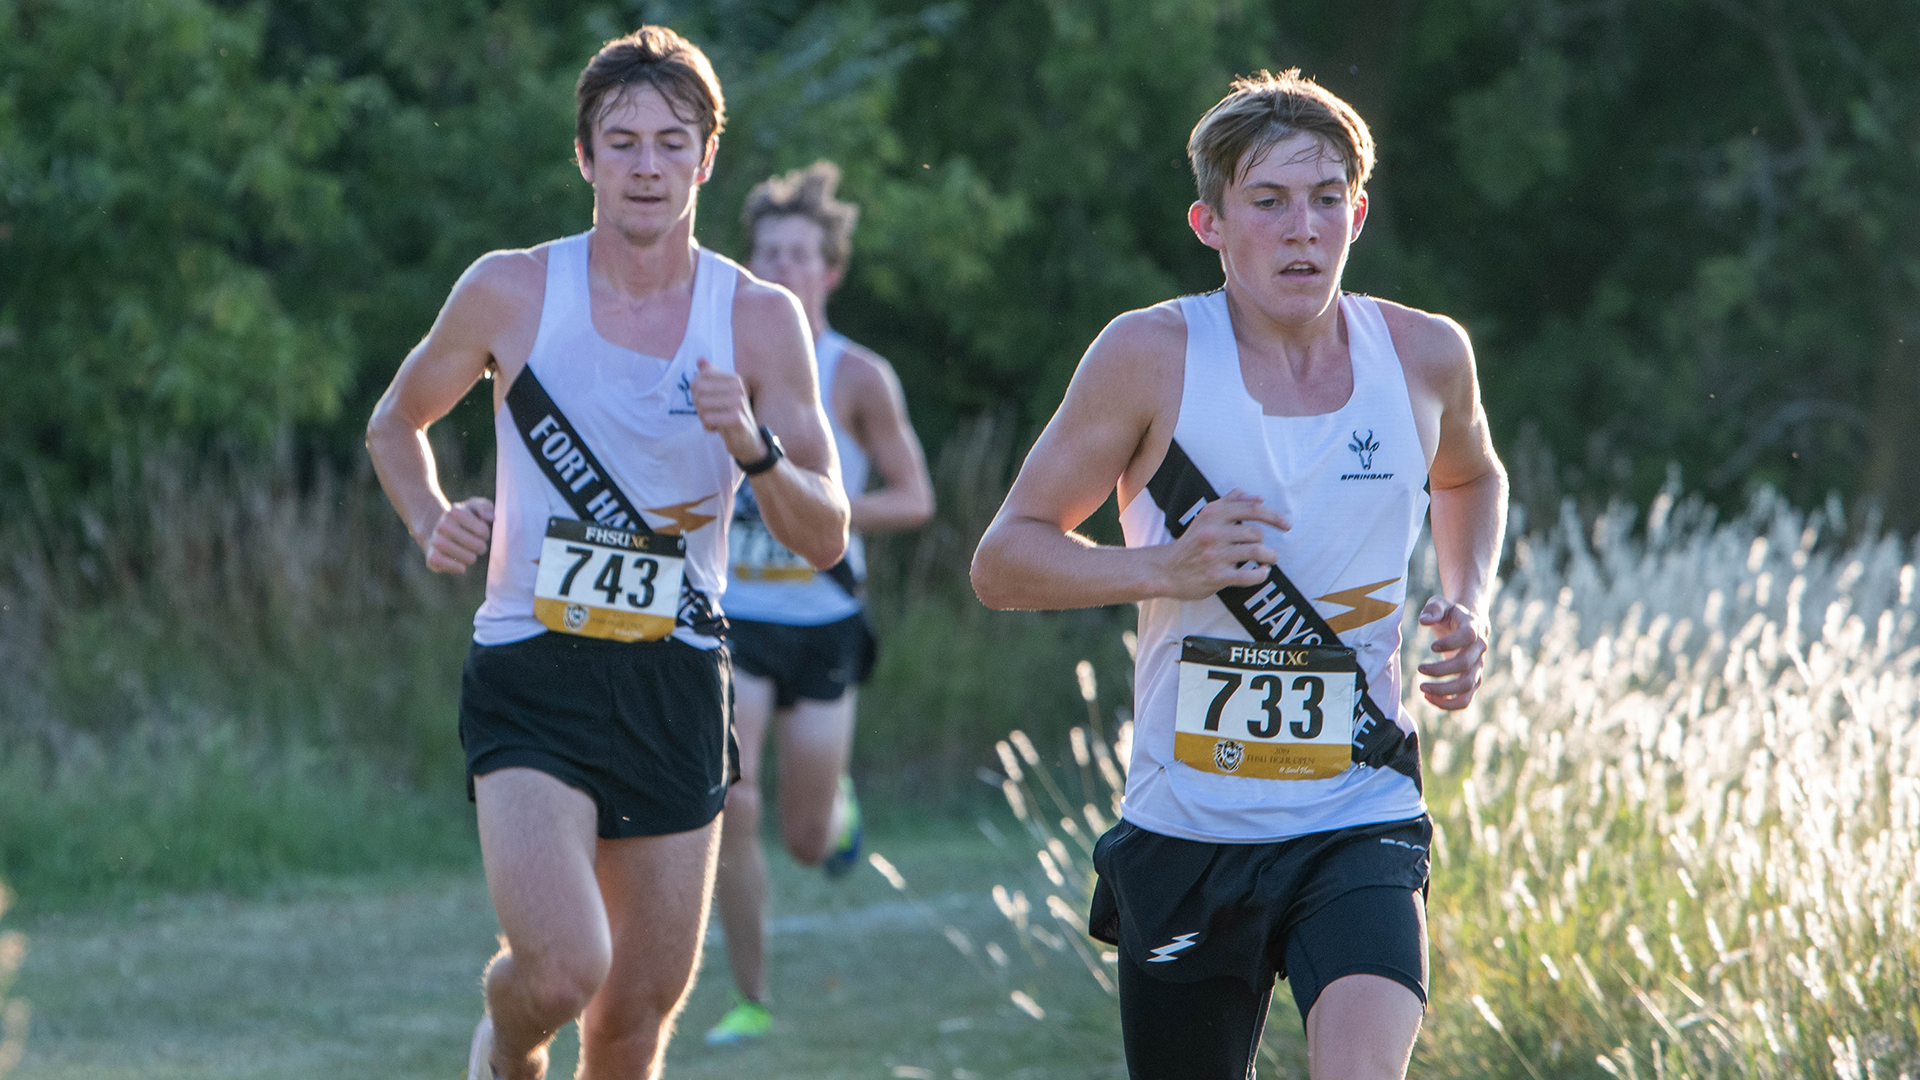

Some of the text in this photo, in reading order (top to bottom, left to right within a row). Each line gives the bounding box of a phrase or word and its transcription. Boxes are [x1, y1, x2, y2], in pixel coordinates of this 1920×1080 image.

[529, 413, 637, 530] FORT HA
[558, 545, 659, 609] 743
[1204, 669, 1325, 740] 733
